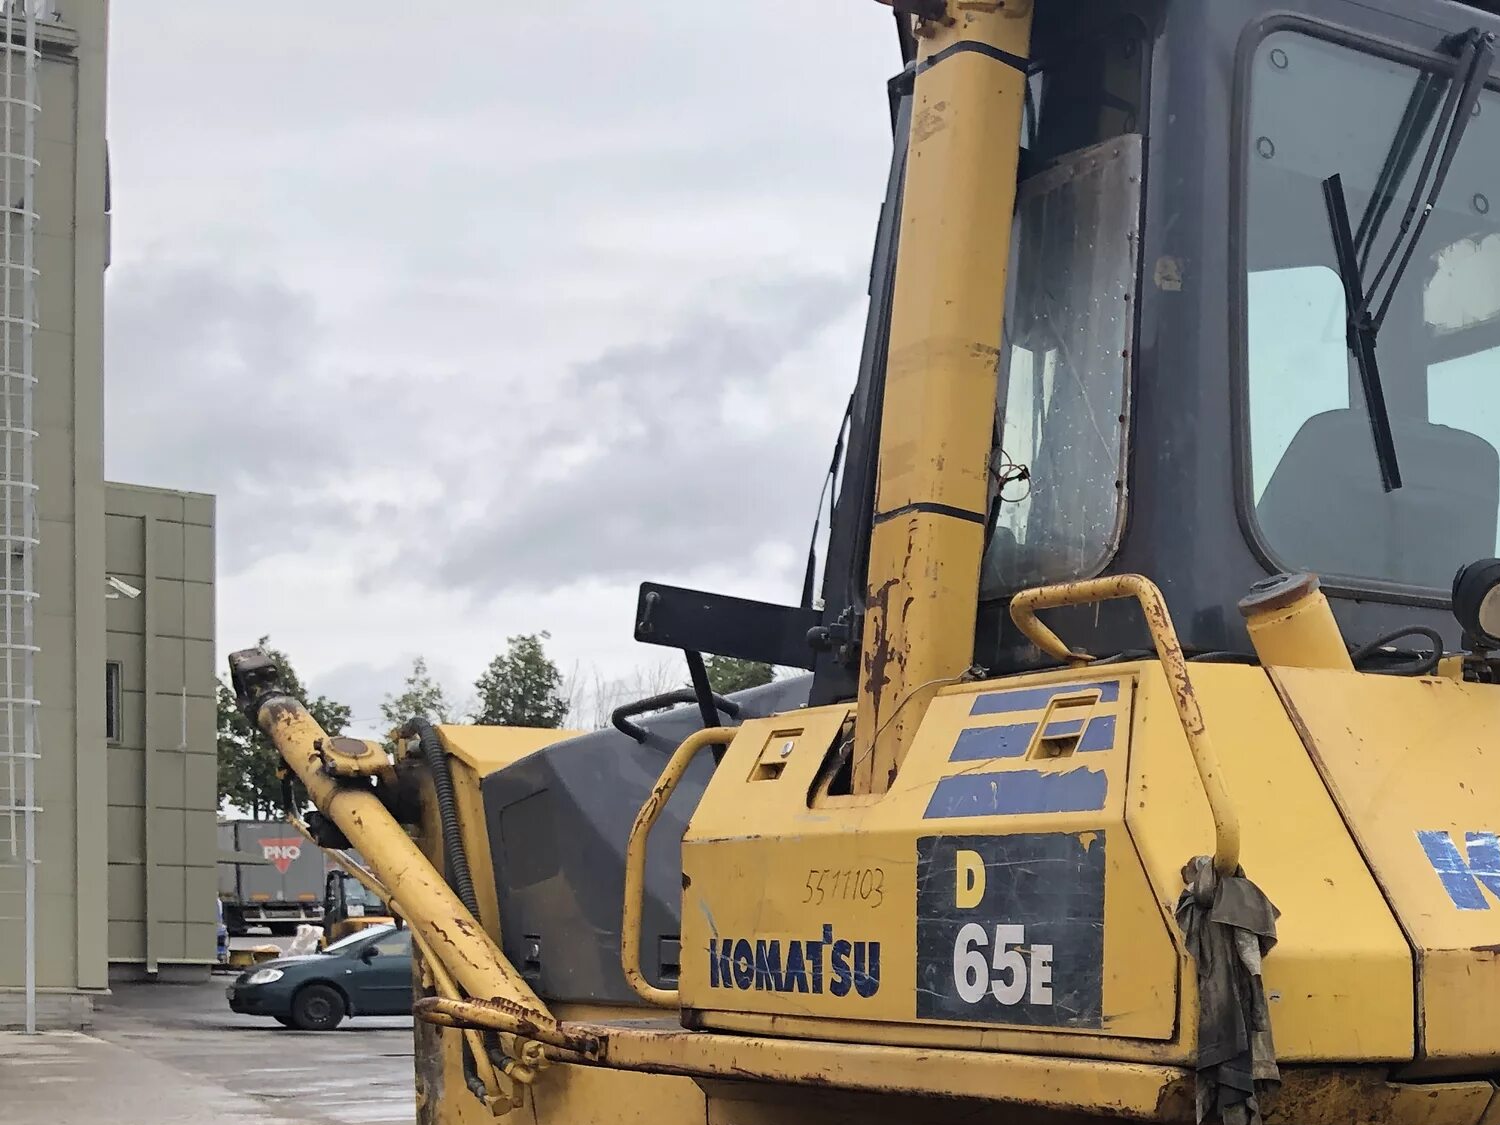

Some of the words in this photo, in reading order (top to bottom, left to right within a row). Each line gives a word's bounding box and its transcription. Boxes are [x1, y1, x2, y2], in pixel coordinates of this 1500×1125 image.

[263, 845, 301, 860] PNO
[956, 850, 987, 909] D
[709, 923, 881, 998] KOMATSU
[953, 922, 1053, 1005] 65E
